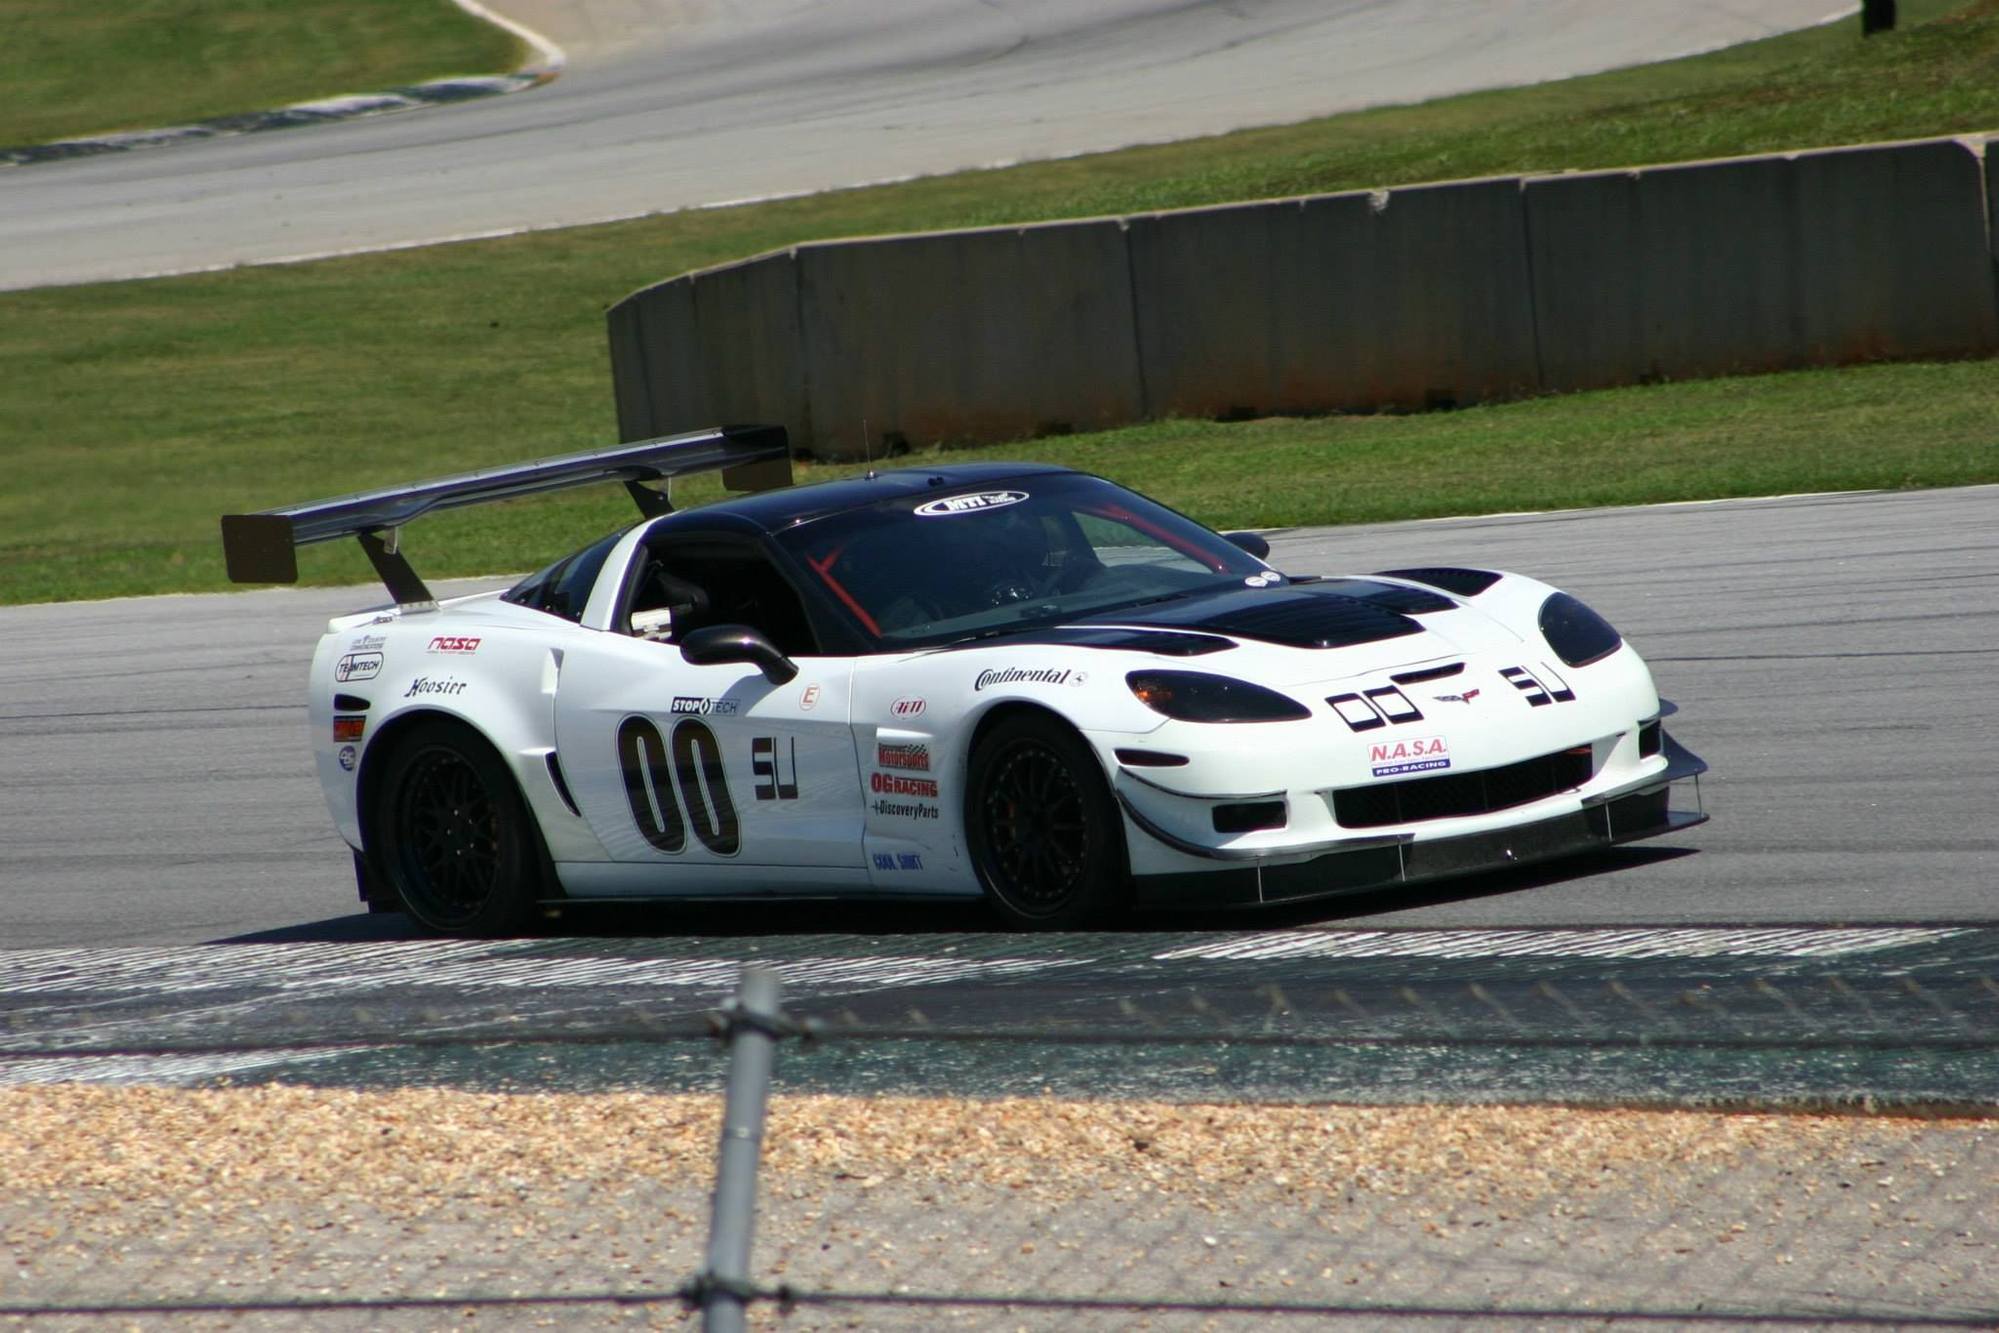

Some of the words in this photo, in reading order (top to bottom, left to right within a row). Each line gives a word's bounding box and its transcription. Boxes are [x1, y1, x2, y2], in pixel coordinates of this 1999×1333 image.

[944, 496, 987, 511] MTI
[403, 676, 467, 698] Hoosier
[975, 667, 1071, 691] Continental
[1324, 685, 1424, 732] 00
[1372, 738, 1447, 761] N.A.S.A.
[615, 713, 742, 857] 00
